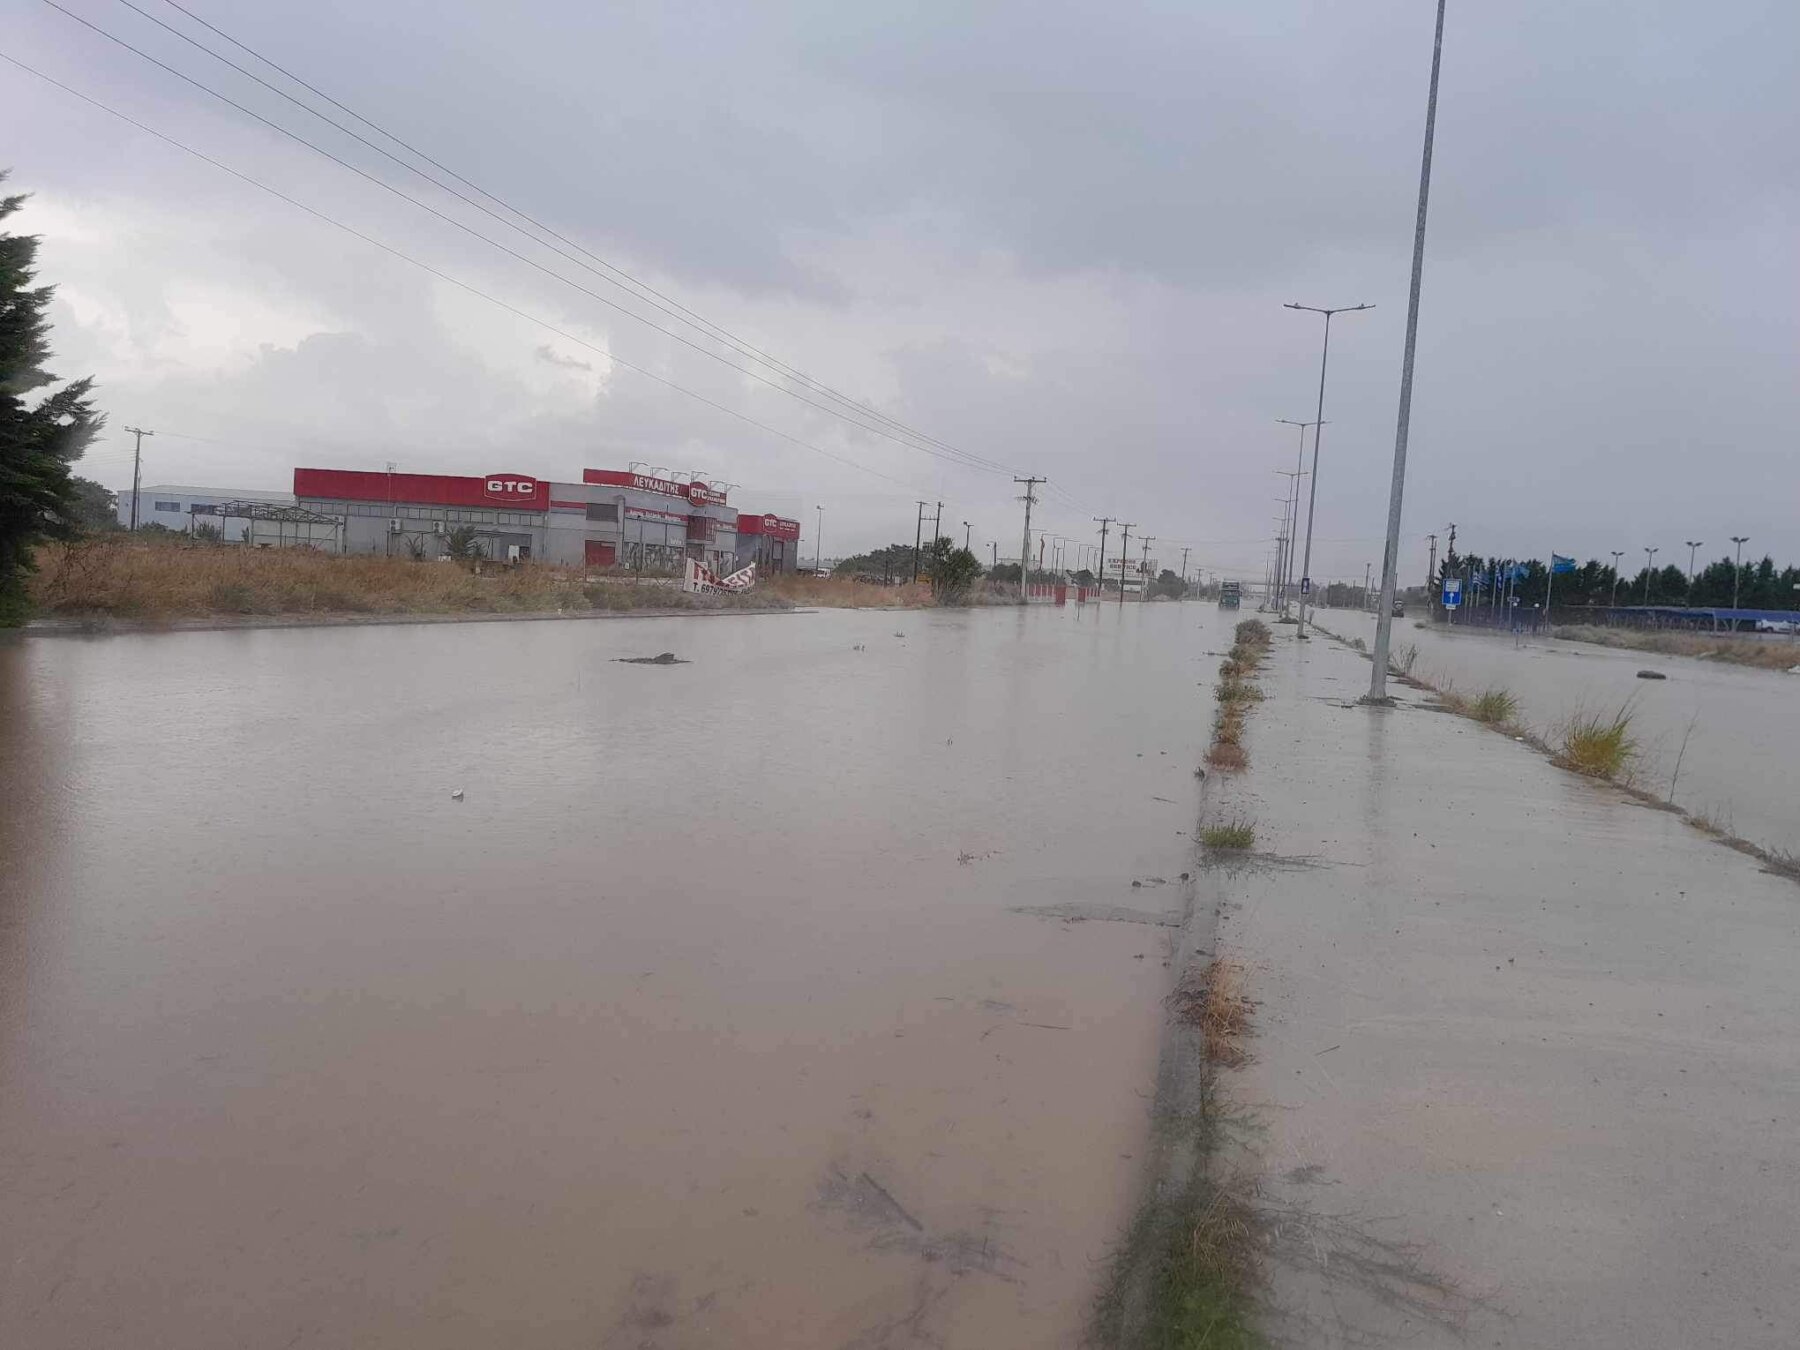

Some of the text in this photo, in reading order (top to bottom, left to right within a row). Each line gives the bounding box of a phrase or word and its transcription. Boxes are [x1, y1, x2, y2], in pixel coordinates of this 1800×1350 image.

[487, 480, 533, 492] GTC
[633, 476, 680, 495] ΛΕΥΚΑΔΙΤΗΣ
[690, 488, 708, 500] GTC
[764, 518, 777, 528] GTC
